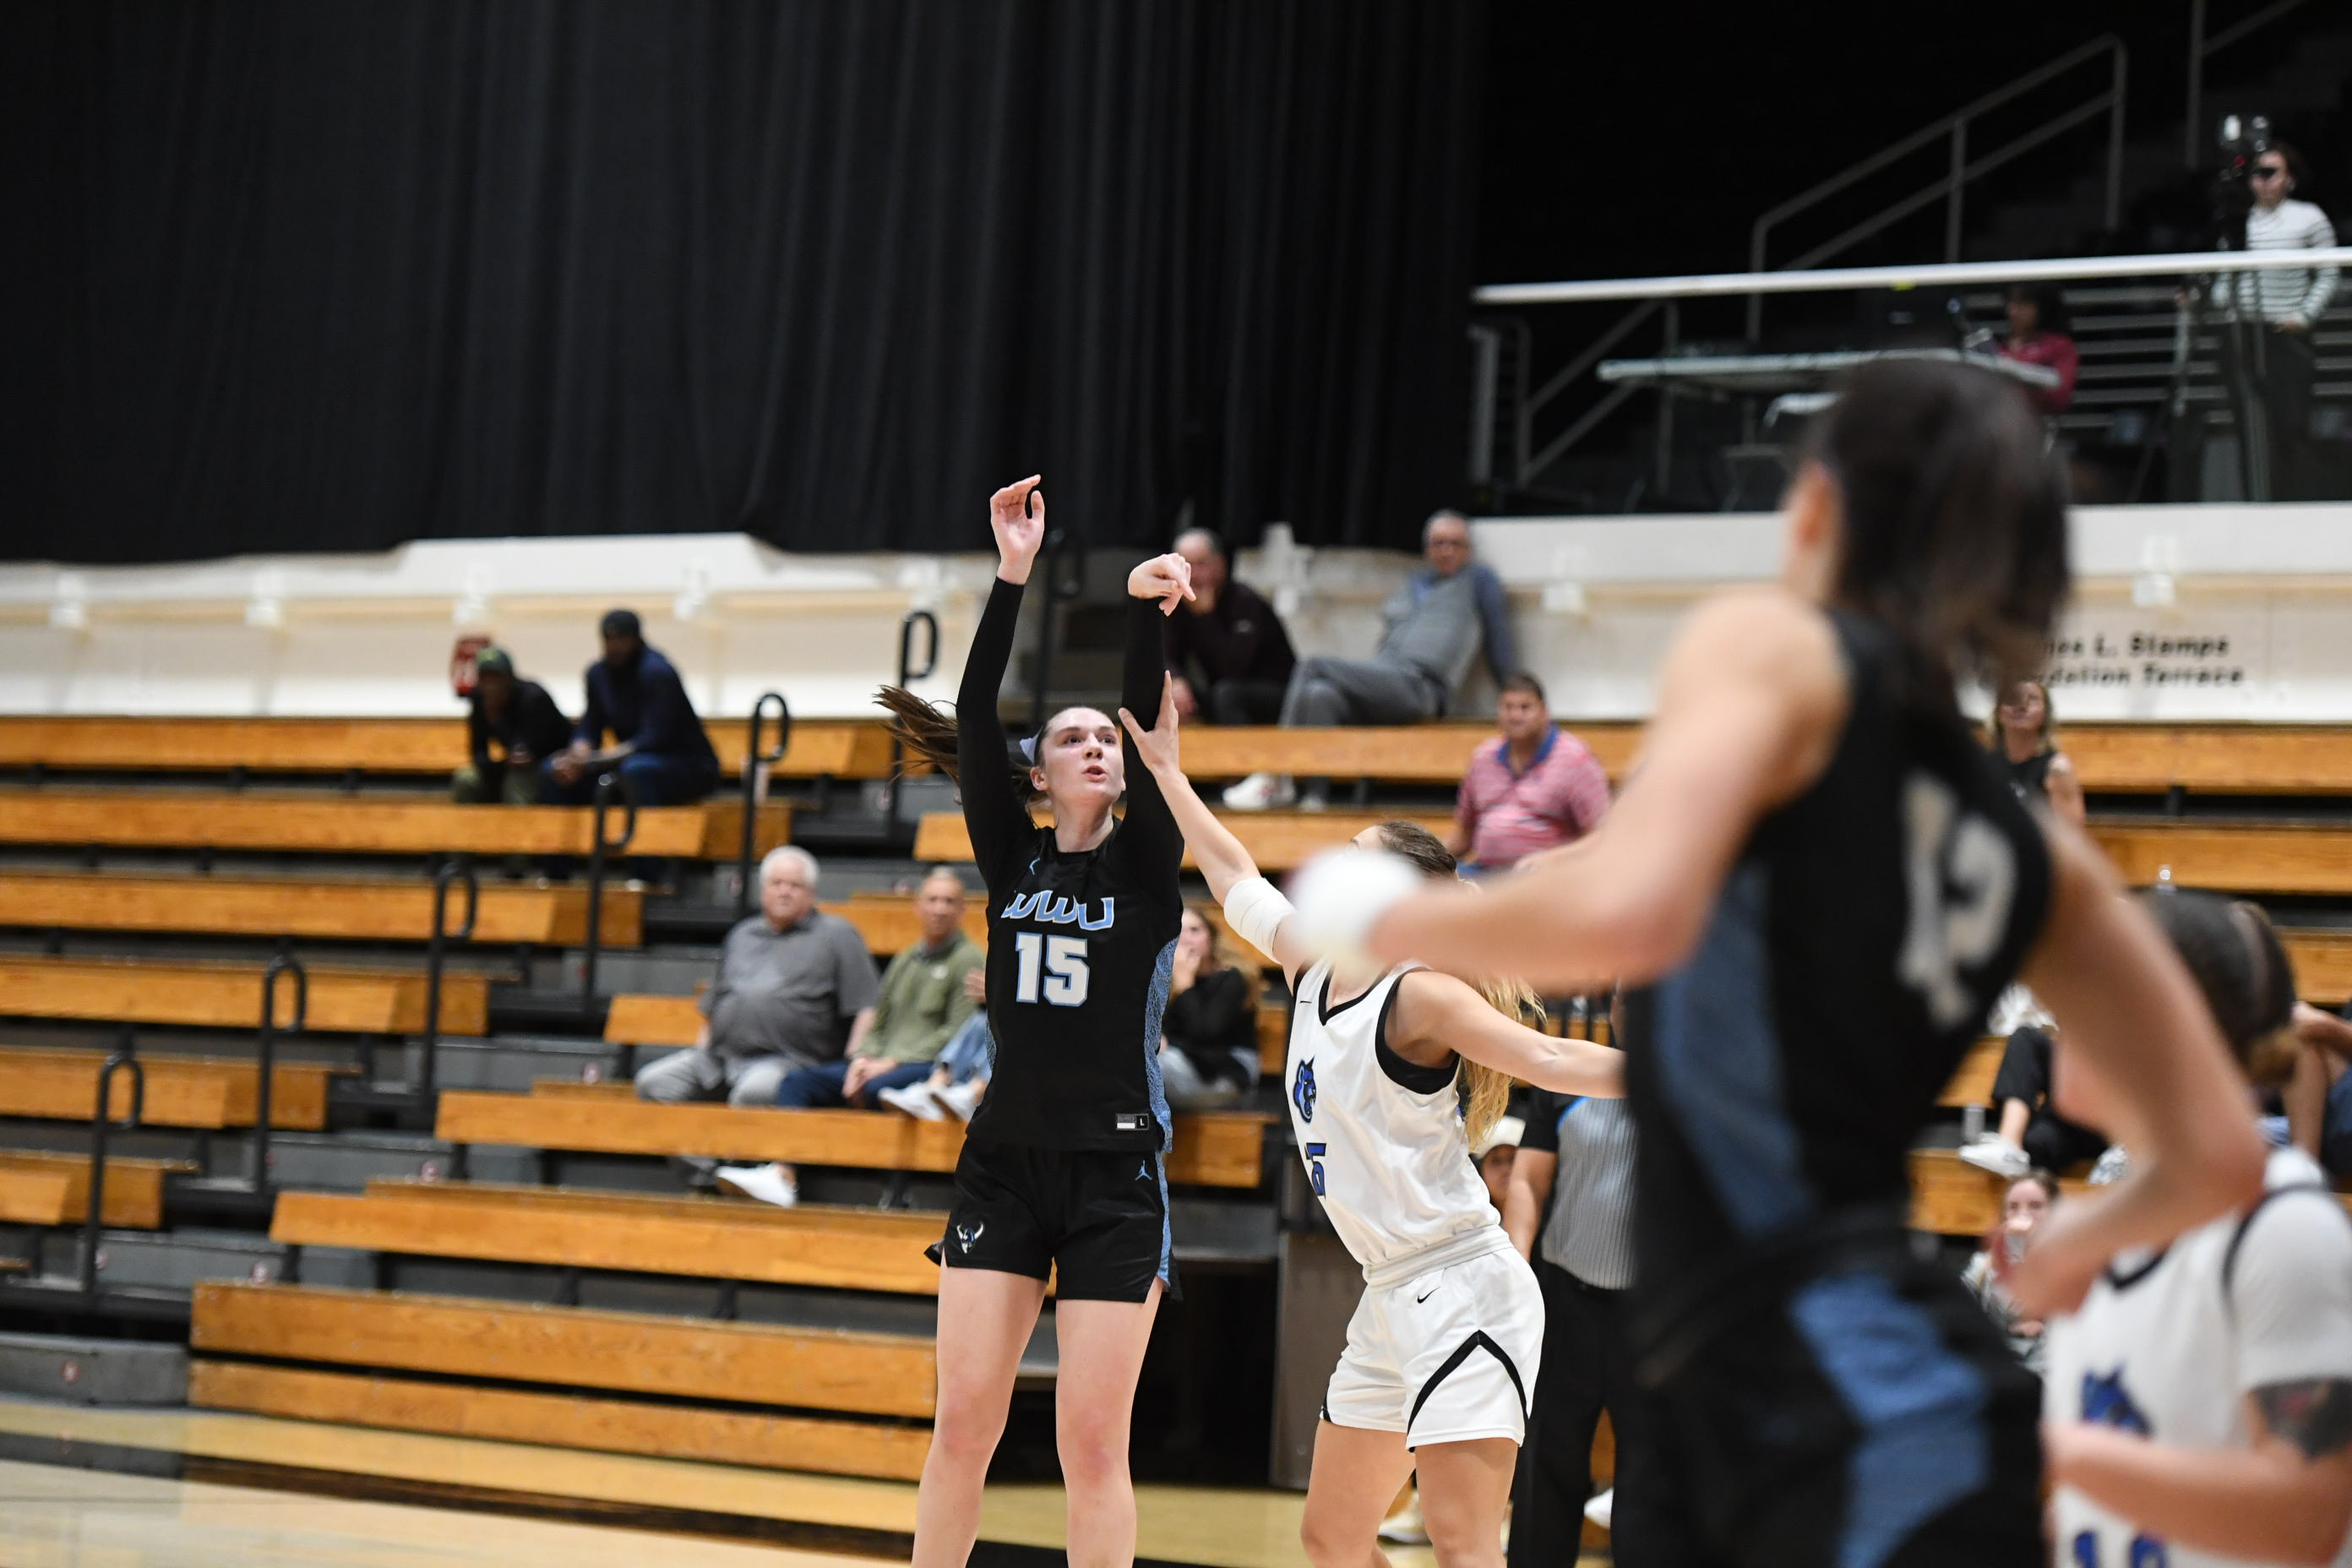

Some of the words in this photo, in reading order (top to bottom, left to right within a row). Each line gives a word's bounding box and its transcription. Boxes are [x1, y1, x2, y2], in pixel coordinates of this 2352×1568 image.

[1001, 890, 1114, 931] WWU
[1015, 931, 1090, 1007] 15
[1139, 1117, 1146, 1127] L
